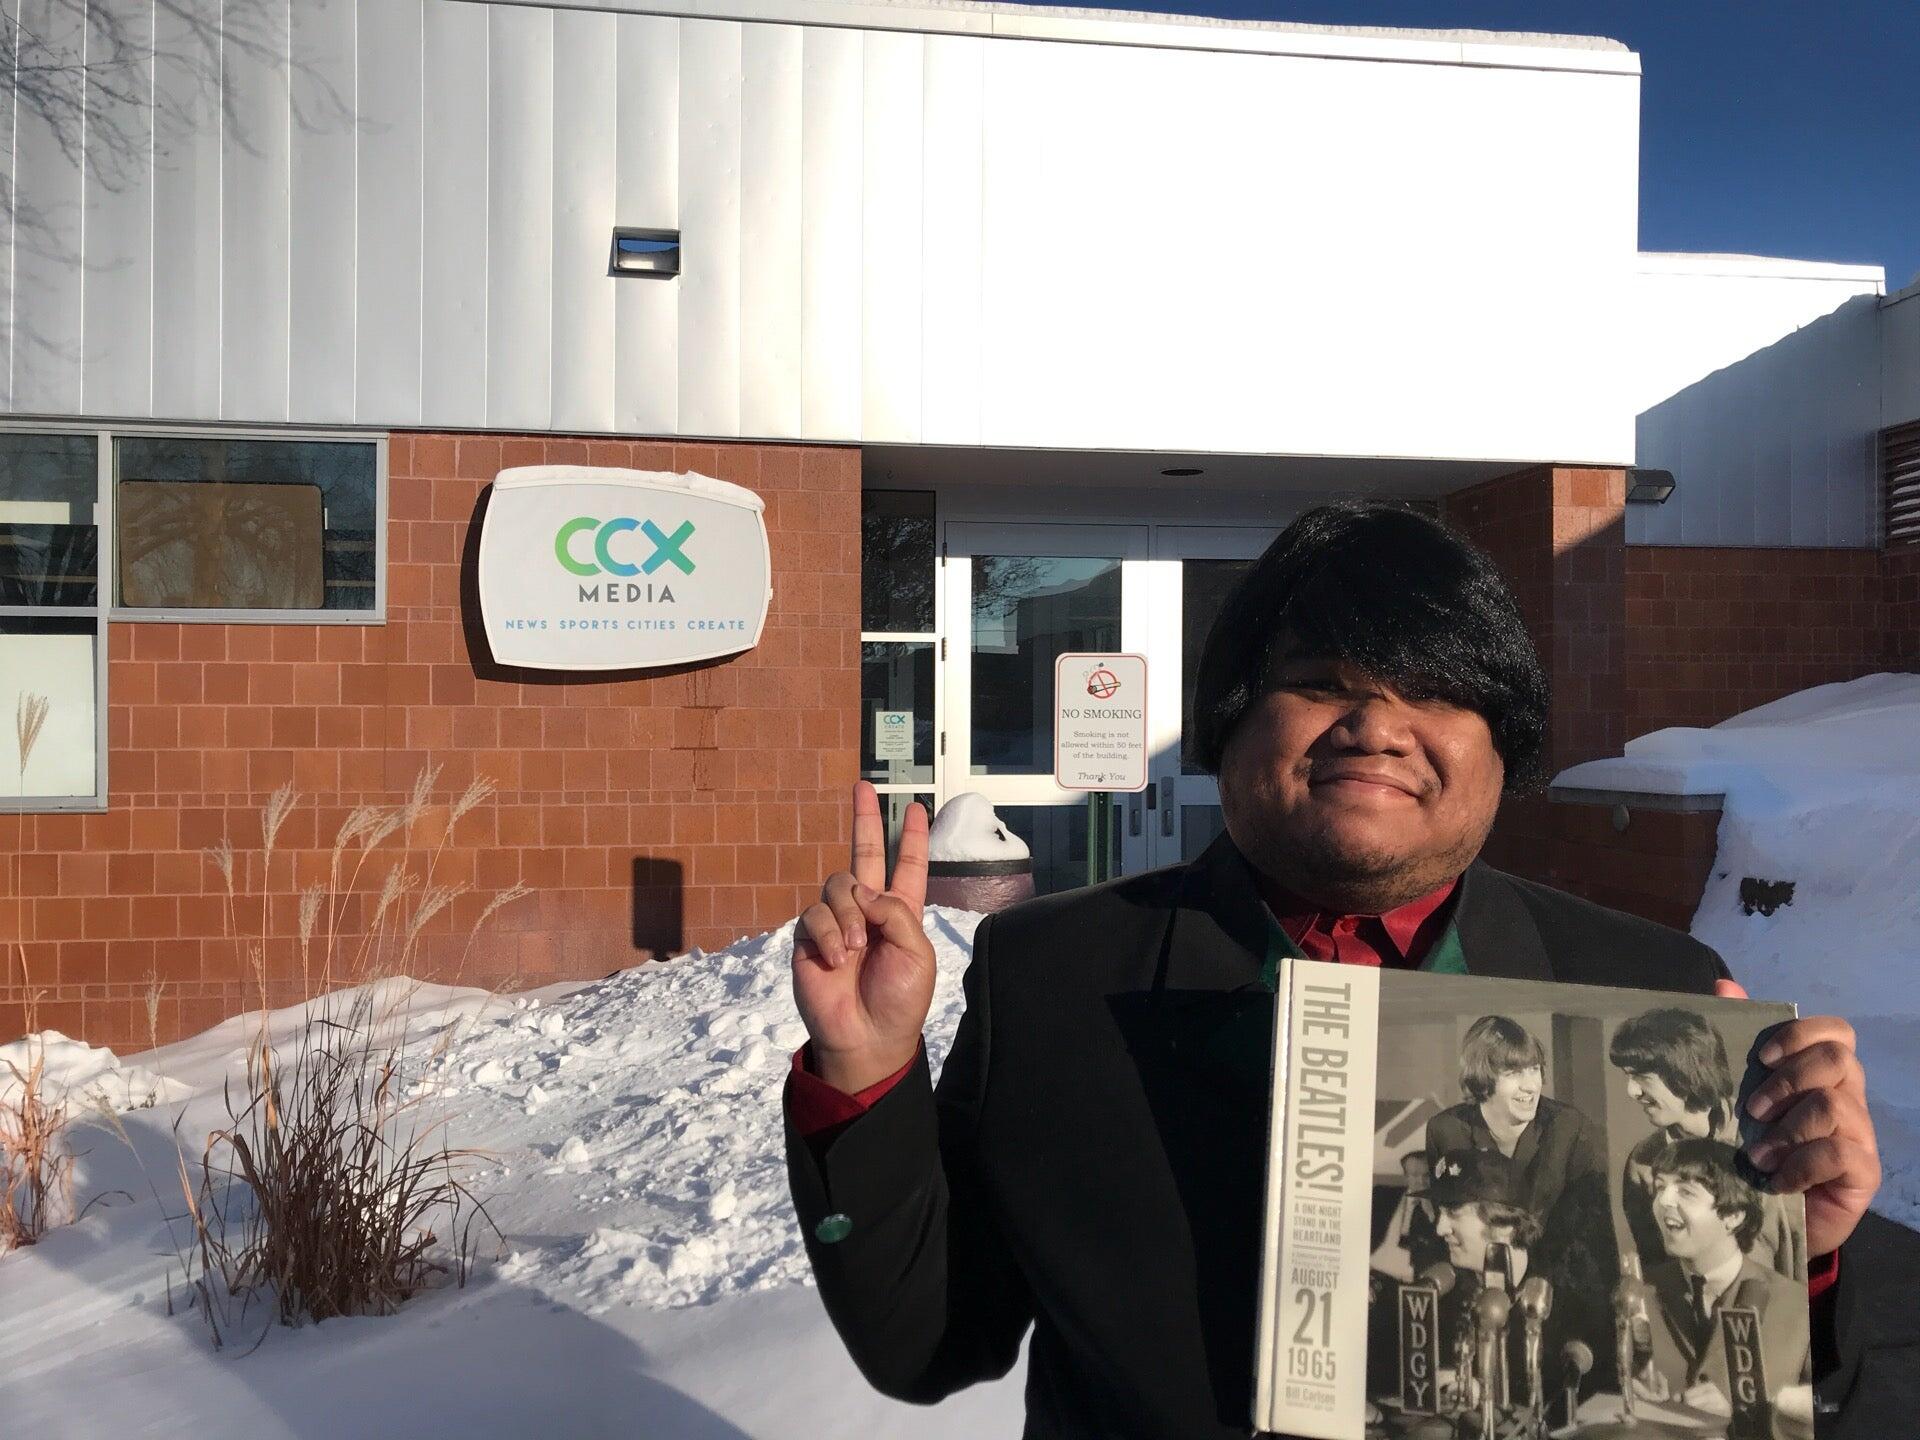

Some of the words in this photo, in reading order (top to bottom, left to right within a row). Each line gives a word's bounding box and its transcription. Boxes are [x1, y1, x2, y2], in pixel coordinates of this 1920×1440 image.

[555, 517, 696, 577] CCX
[578, 583, 676, 603] MEDIA
[505, 619, 548, 630] NEWS
[559, 619, 619, 630] SPORTS
[627, 619, 676, 630] CITIES
[687, 619, 745, 630] CREATE
[883, 714, 906, 725] CCX
[1062, 709, 1080, 719] NO
[1083, 709, 1142, 720] SMOKING
[1073, 731, 1106, 739] Smoking
[1061, 741, 1089, 749] allowed
[1091, 741, 1115, 749] within
[1128, 741, 1142, 749] feet
[1078, 772, 1106, 780] Thank
[1109, 772, 1126, 780] You
[1302, 983, 1351, 1039] THE
[1295, 1046, 1349, 1193] BEATLES!
[1294, 1202, 1299, 1213] A
[1293, 1216, 1316, 1227] STAND
[1319, 1218, 1327, 1229] IN
[1329, 1219, 1341, 1231] THE
[1292, 1229, 1341, 1246] HEARTLAND
[1291, 1267, 1340, 1289] AUGUST
[1292, 1288, 1332, 1348] 21
[1406, 1293, 1430, 1408] WDGY
[1288, 1347, 1336, 1381] 1965
[1726, 1316, 1756, 1411] WDG
[1286, 1386, 1300, 1400] Bill
